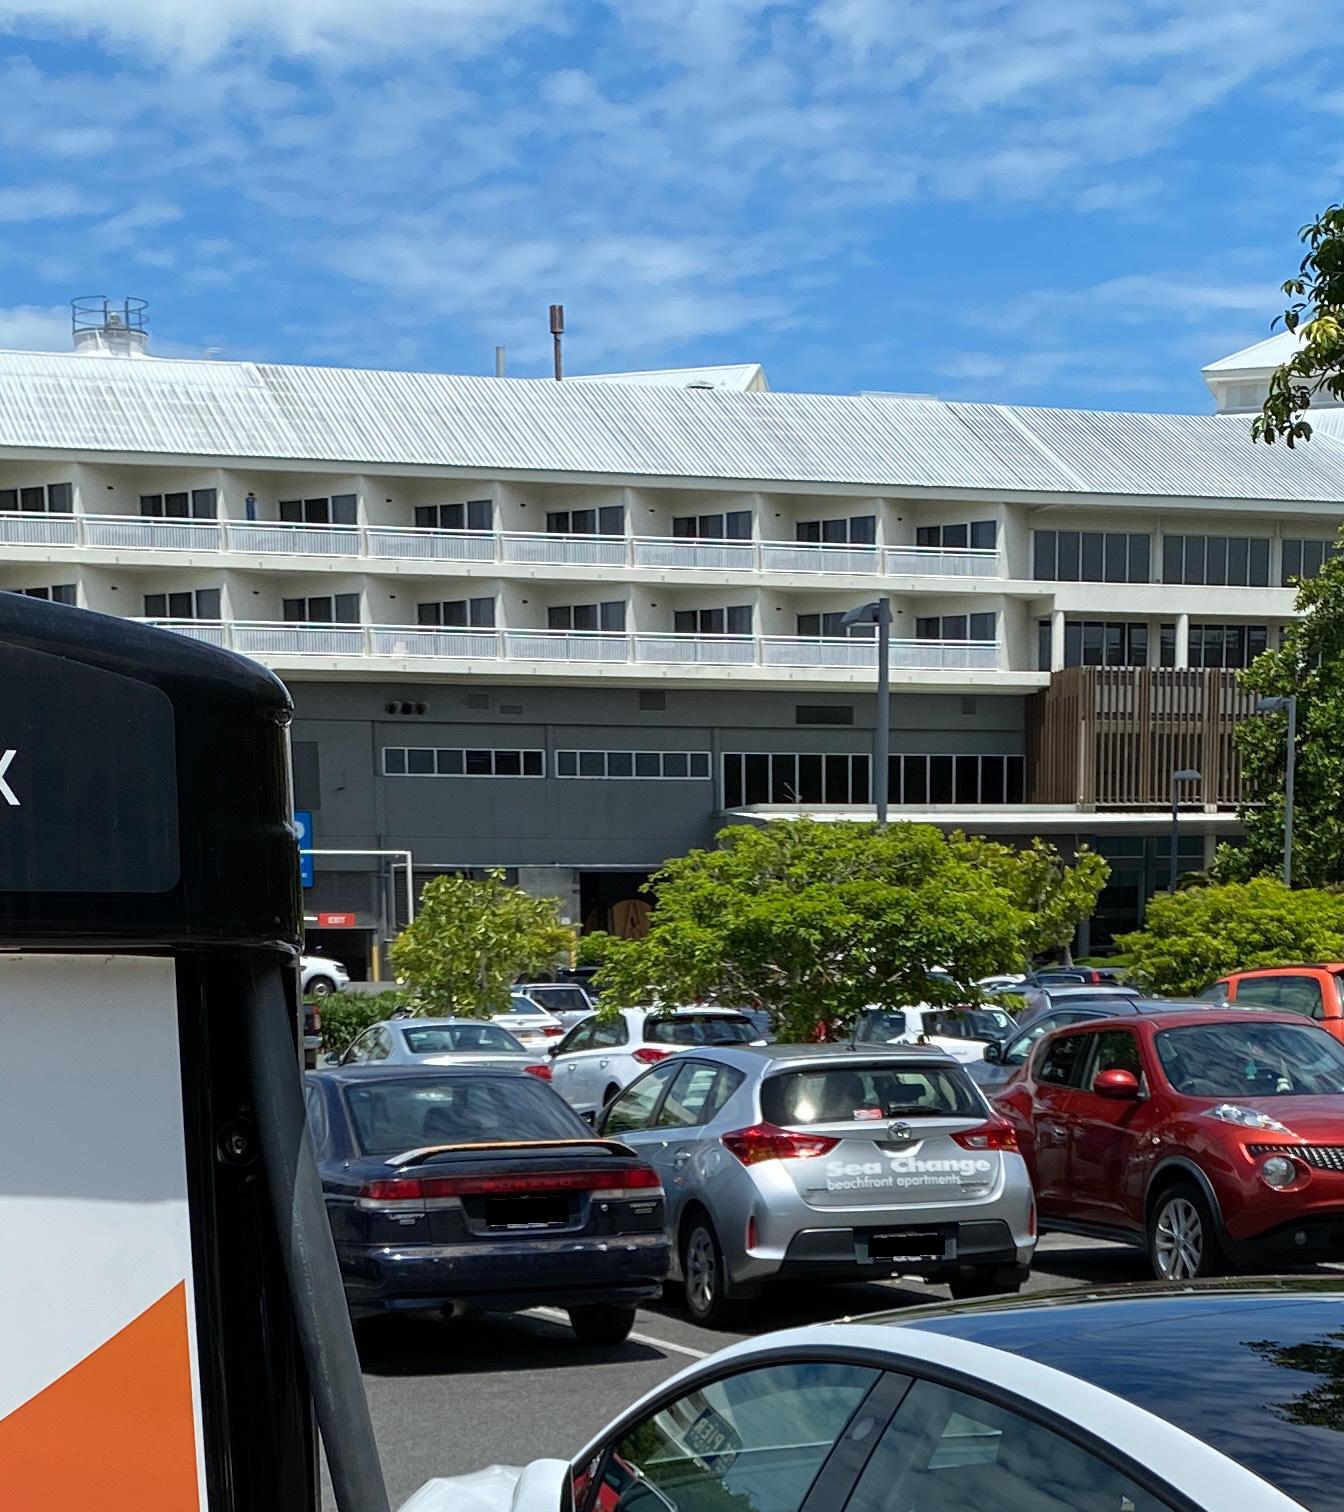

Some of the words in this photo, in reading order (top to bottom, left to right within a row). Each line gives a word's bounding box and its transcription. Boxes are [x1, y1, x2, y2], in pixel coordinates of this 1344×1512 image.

[825, 1160, 882, 1177] Sea
[890, 1157, 992, 1176] Change
[826, 1175, 893, 1191] beachfront
[896, 1174, 962, 1188] apartments
